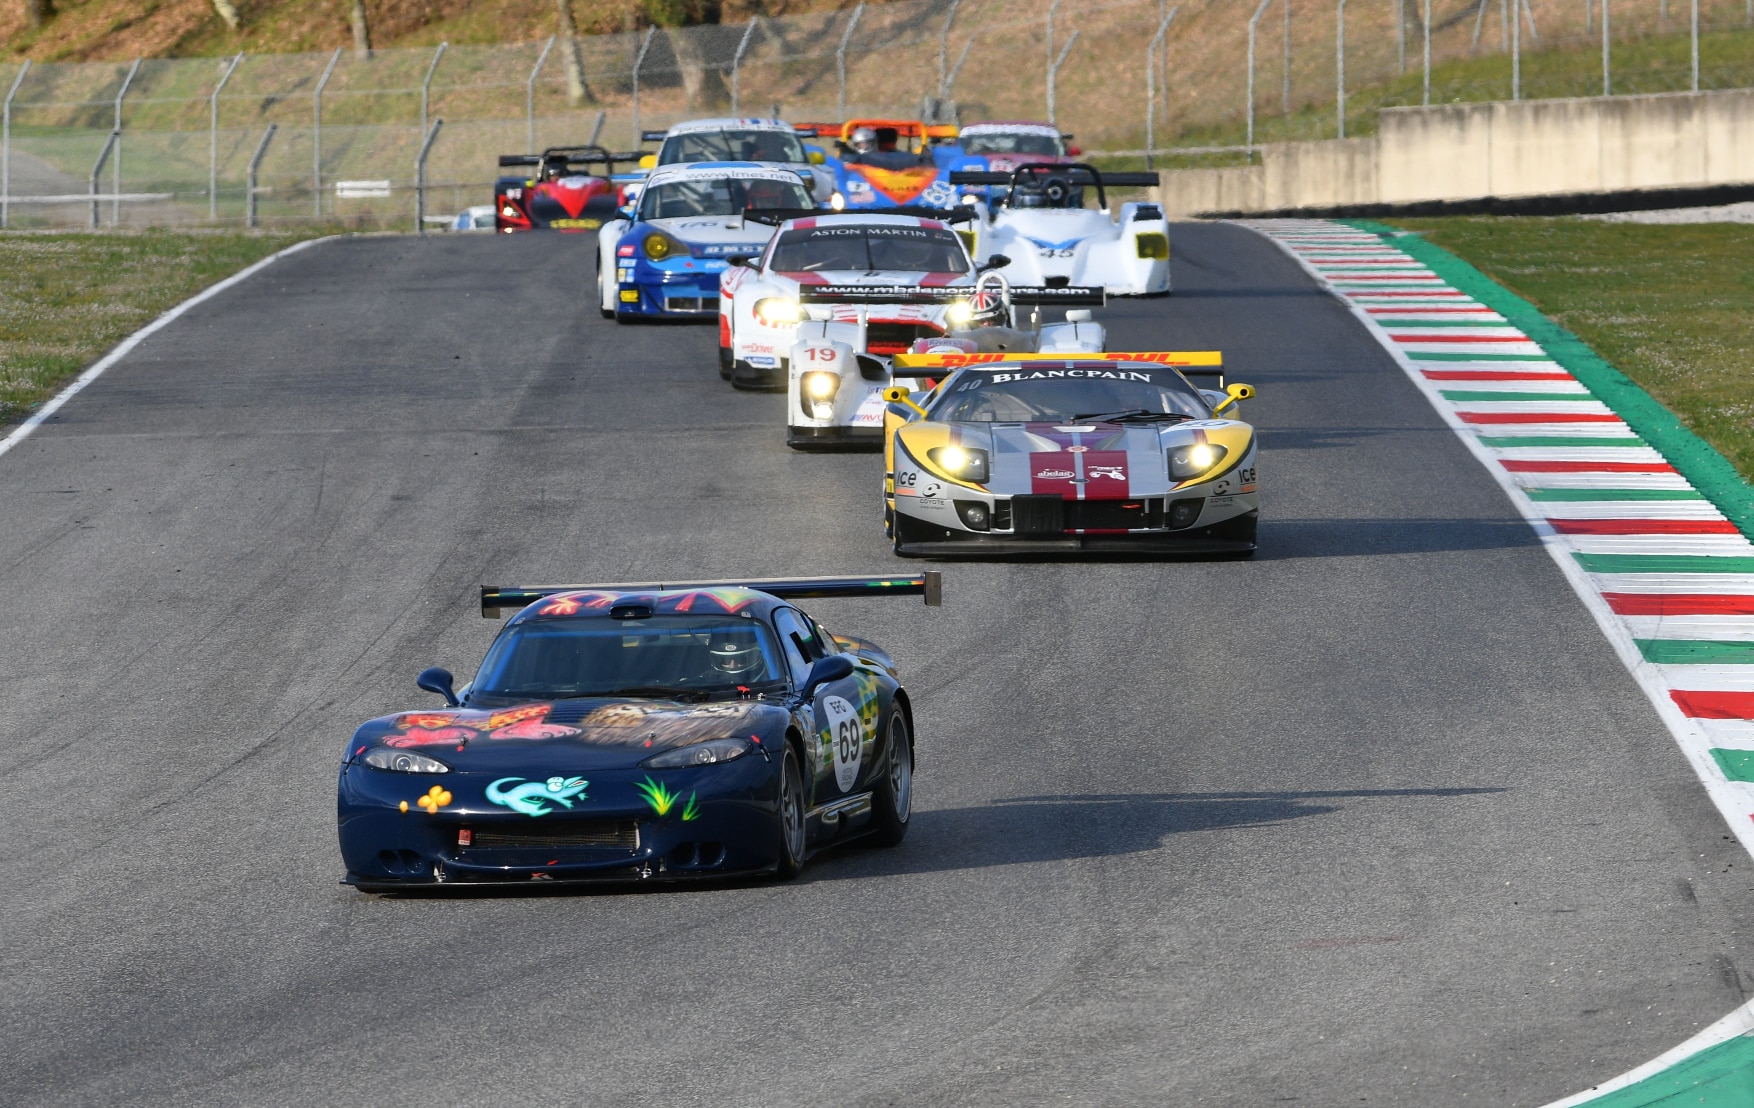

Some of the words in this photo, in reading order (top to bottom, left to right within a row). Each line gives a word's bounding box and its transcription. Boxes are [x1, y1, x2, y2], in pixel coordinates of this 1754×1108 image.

[811, 228, 860, 237] ASTON
[867, 228, 927, 237] MARTIN
[804, 347, 836, 361] 19
[1105, 353, 1175, 364] DHL
[991, 369, 1152, 384] BLANCPAIN
[957, 379, 983, 392] 40
[839, 718, 860, 764] 69
